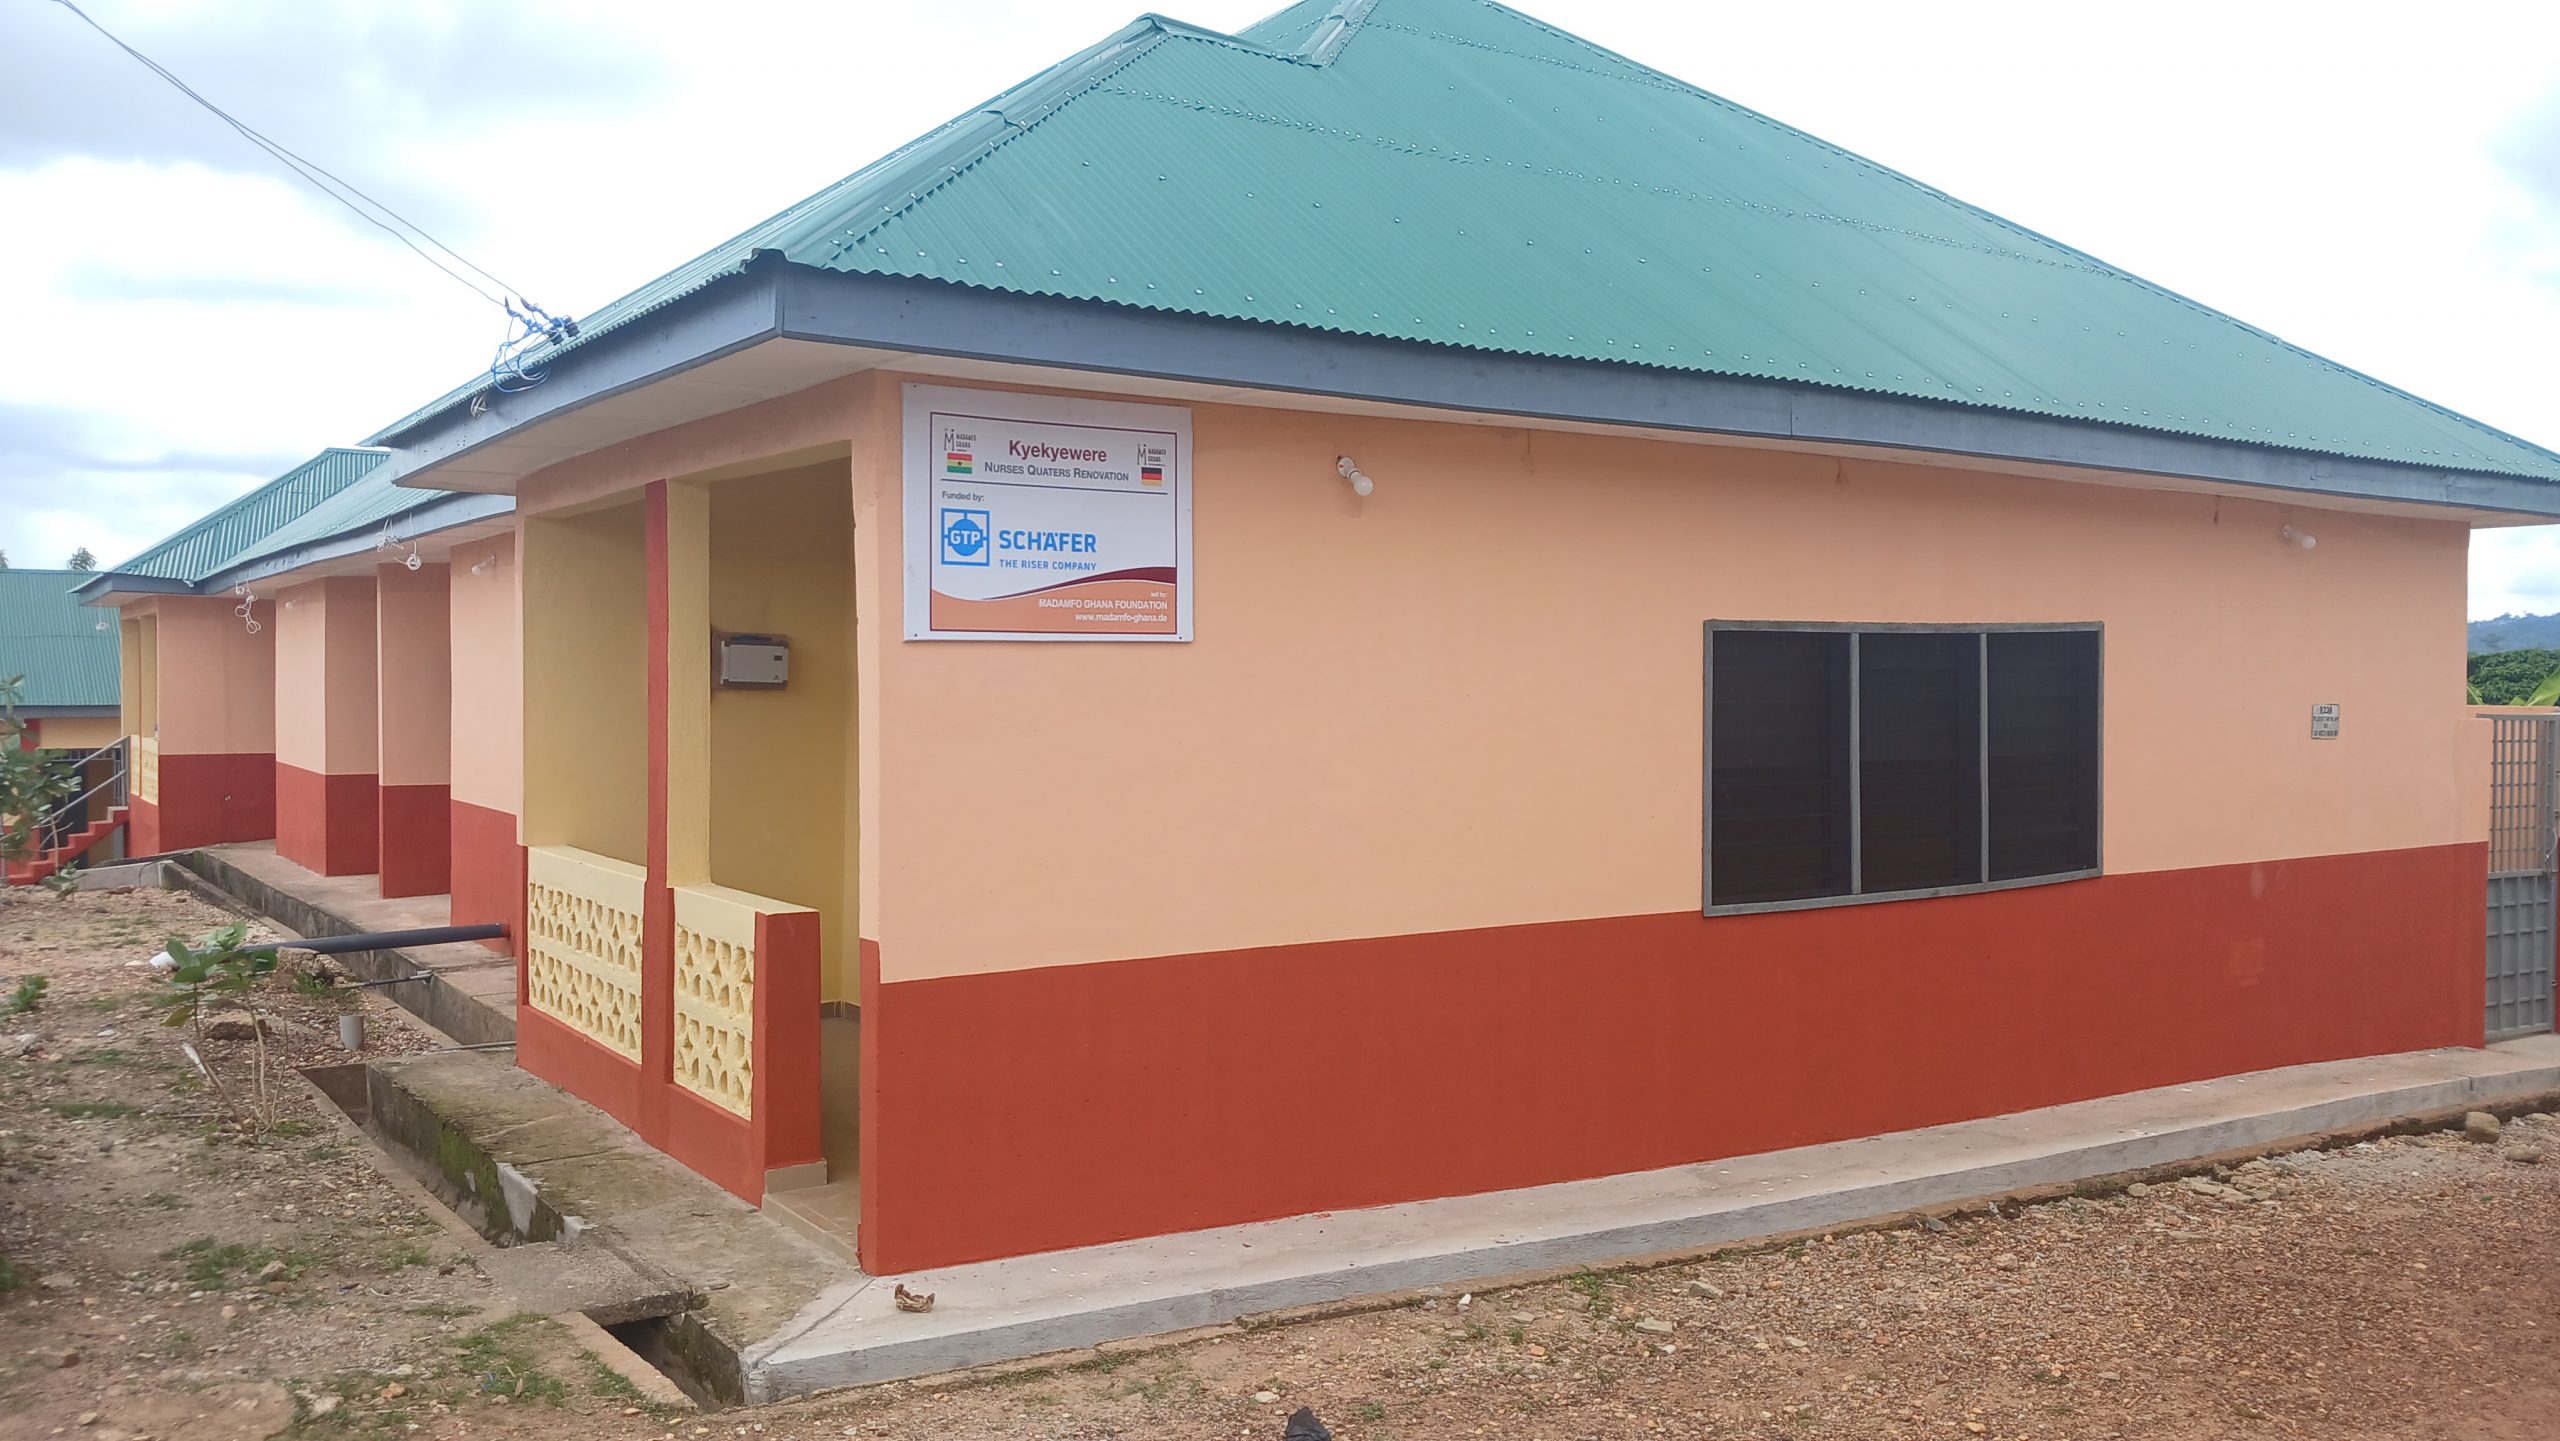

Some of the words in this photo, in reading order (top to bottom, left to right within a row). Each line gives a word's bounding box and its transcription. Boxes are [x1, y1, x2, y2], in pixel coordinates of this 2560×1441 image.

[1009, 440, 1107, 462] Kyekyewere
[984, 462, 1024, 475] NURSES
[1027, 465, 1071, 478] QUATERS
[1073, 467, 1129, 481] RENOVATION
[942, 491, 971, 501] Funded
[973, 493, 985, 502] by:
[950, 530, 981, 546] GTP
[999, 530, 1097, 553] SCHÄFER
[1000, 559, 1018, 568] THE
[1021, 560, 1049, 569] RISER
[1052, 561, 1097, 571] COMPANY
[1039, 599, 1082, 609] MADAMFO
[1083, 599, 1114, 609] GHANA
[1115, 600, 1168, 610] FOUNDATION
[1075, 612, 1168, 623] www.madamfo-ghana.de
